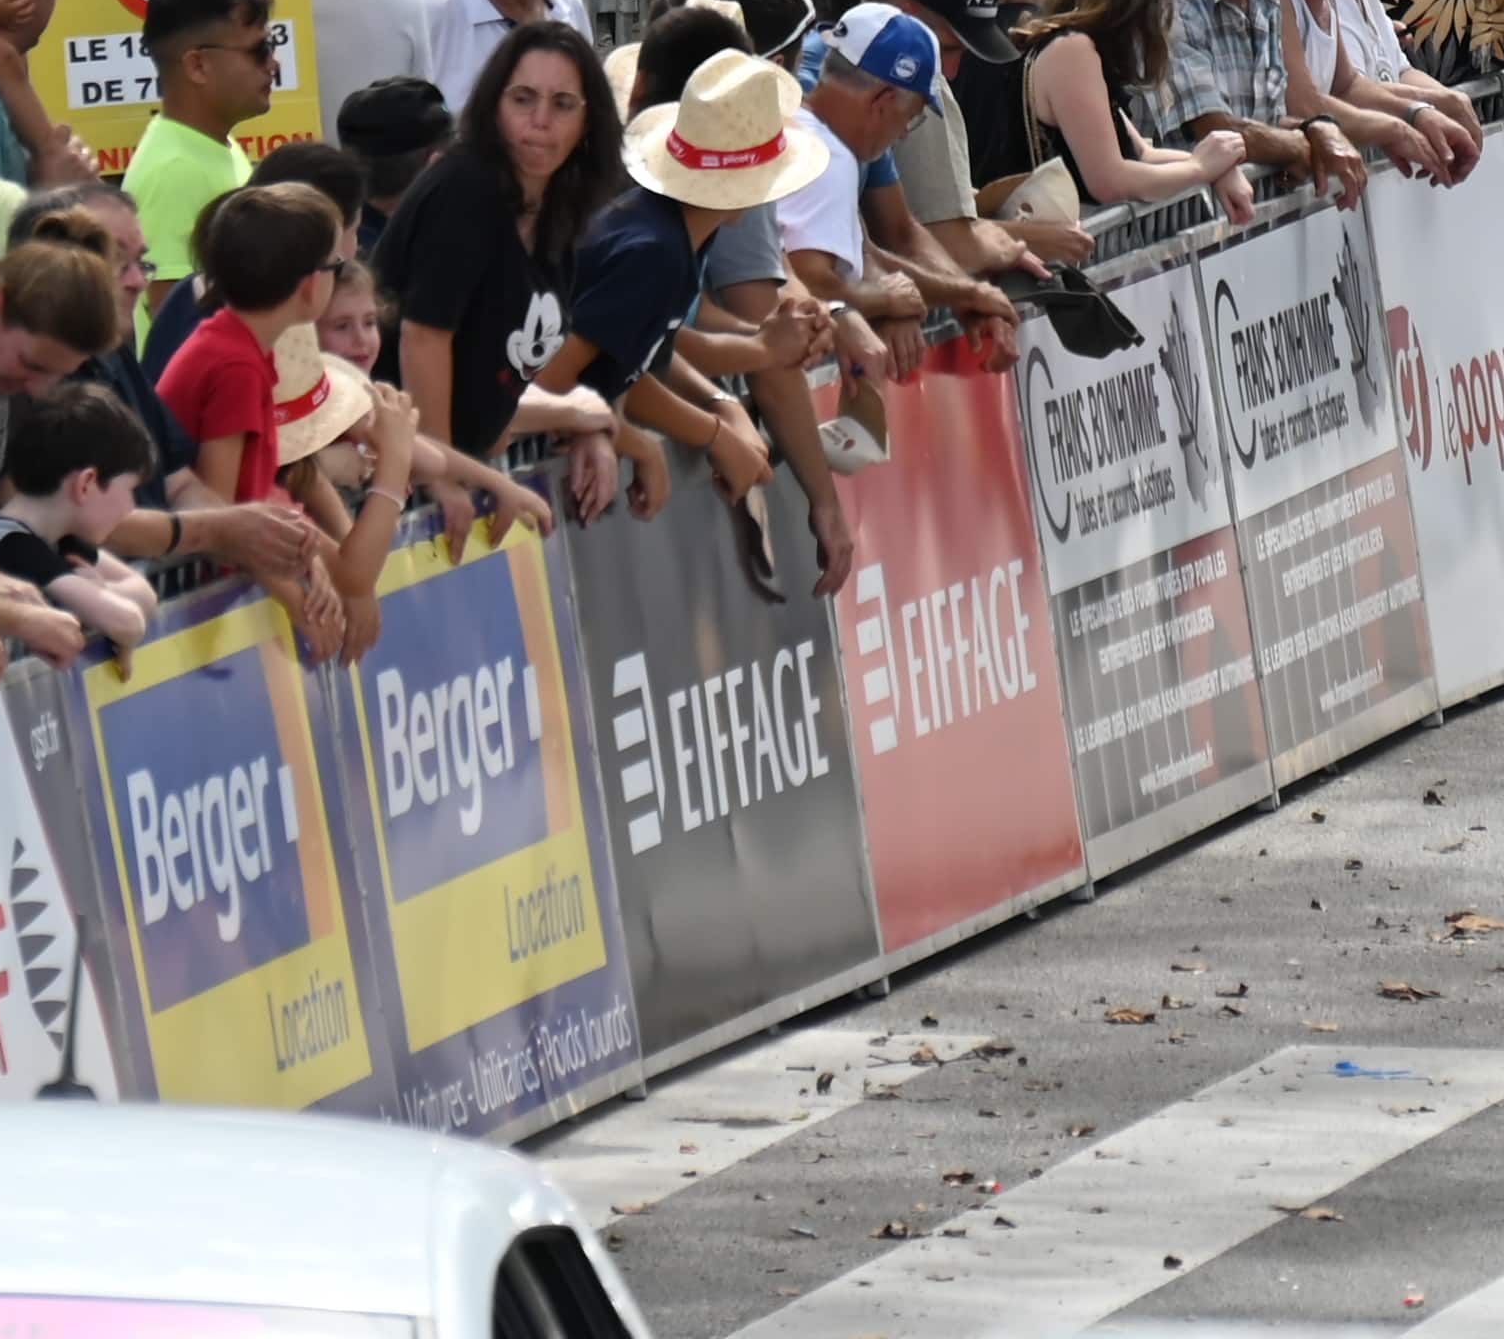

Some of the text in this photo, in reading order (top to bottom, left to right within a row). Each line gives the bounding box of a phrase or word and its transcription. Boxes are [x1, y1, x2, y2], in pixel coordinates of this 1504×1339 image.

[68, 38, 109, 64] LE
[82, 79, 125, 106] DE
[1232, 282, 1341, 412] FRANS BONHOMME
[1045, 362, 1166, 487] FRANS BONHOMME
[903, 559, 1037, 738] EIFFAGE
[376, 653, 516, 837] Berger
[668, 638, 830, 833] EIFFAGE
[126, 753, 279, 943] Berger
[507, 863, 587, 965] Location
[268, 971, 351, 1075] Location
[540, 1016, 587, 1083] Poids
